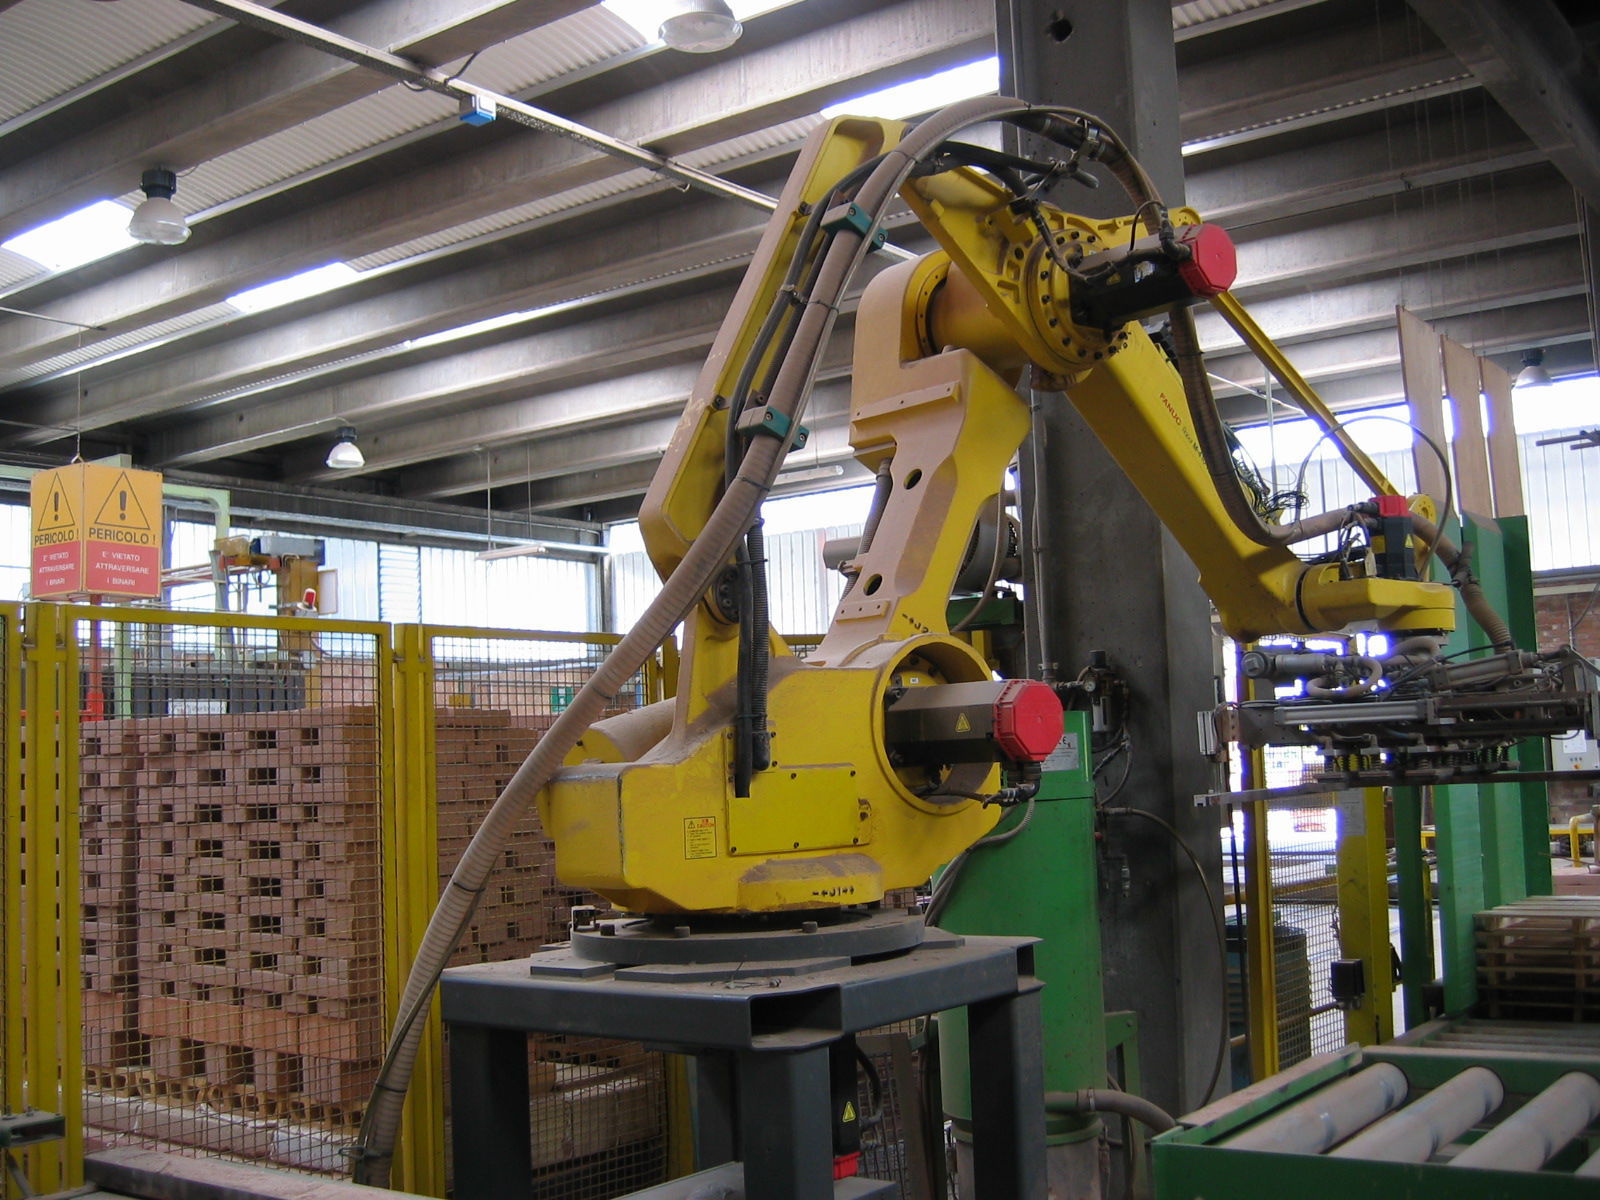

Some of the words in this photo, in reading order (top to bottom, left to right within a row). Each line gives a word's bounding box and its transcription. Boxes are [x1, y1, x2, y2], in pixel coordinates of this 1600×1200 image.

[1160, 392, 1182, 426] FANUC
[34, 529, 75, 546] PERICOLO
[88, 527, 150, 545] PERICOLO
[111, 552, 141, 562] VIETATO
[39, 563, 75, 574] ATTRAVERSARE
[95, 562, 150, 575] ATTRAVERSARE
[112, 577, 136, 586] BINARI
